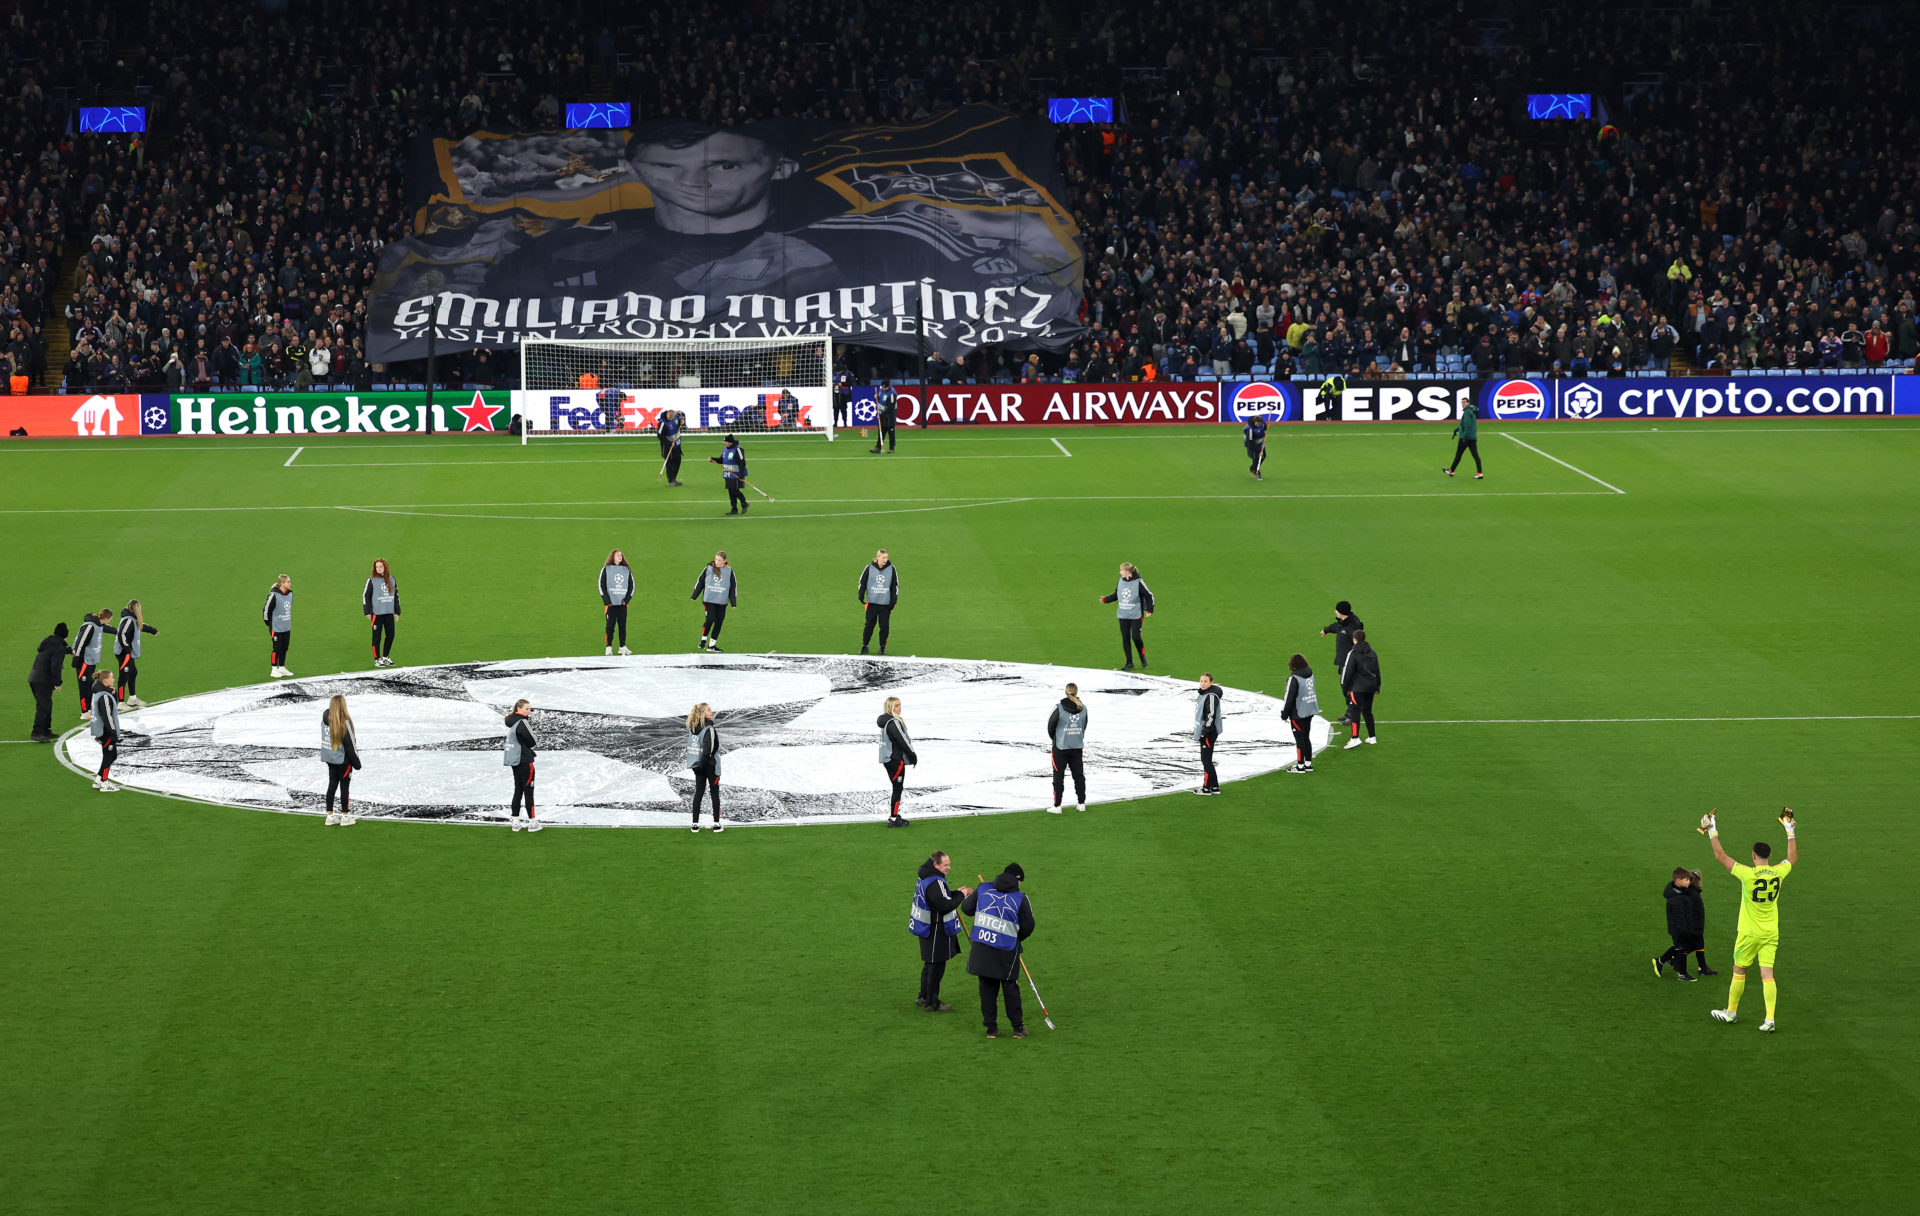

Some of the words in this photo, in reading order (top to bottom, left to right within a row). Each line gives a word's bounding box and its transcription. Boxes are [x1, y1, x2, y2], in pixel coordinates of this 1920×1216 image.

[571, 318, 747, 339] TROPHY
[758, 315, 948, 339] WINNER
[895, 392, 1025, 427] QATAR
[1043, 390, 1215, 420] AIRWAYS
[1236, 400, 1282, 412] PEPSI
[1496, 398, 1542, 410] PEPSI
[1618, 381, 1884, 418] crypto.com
[176, 395, 450, 434] Heineken
[1752, 876, 1780, 903] 23
[977, 914, 1007, 932] PITCH
[978, 929, 998, 944] 003
